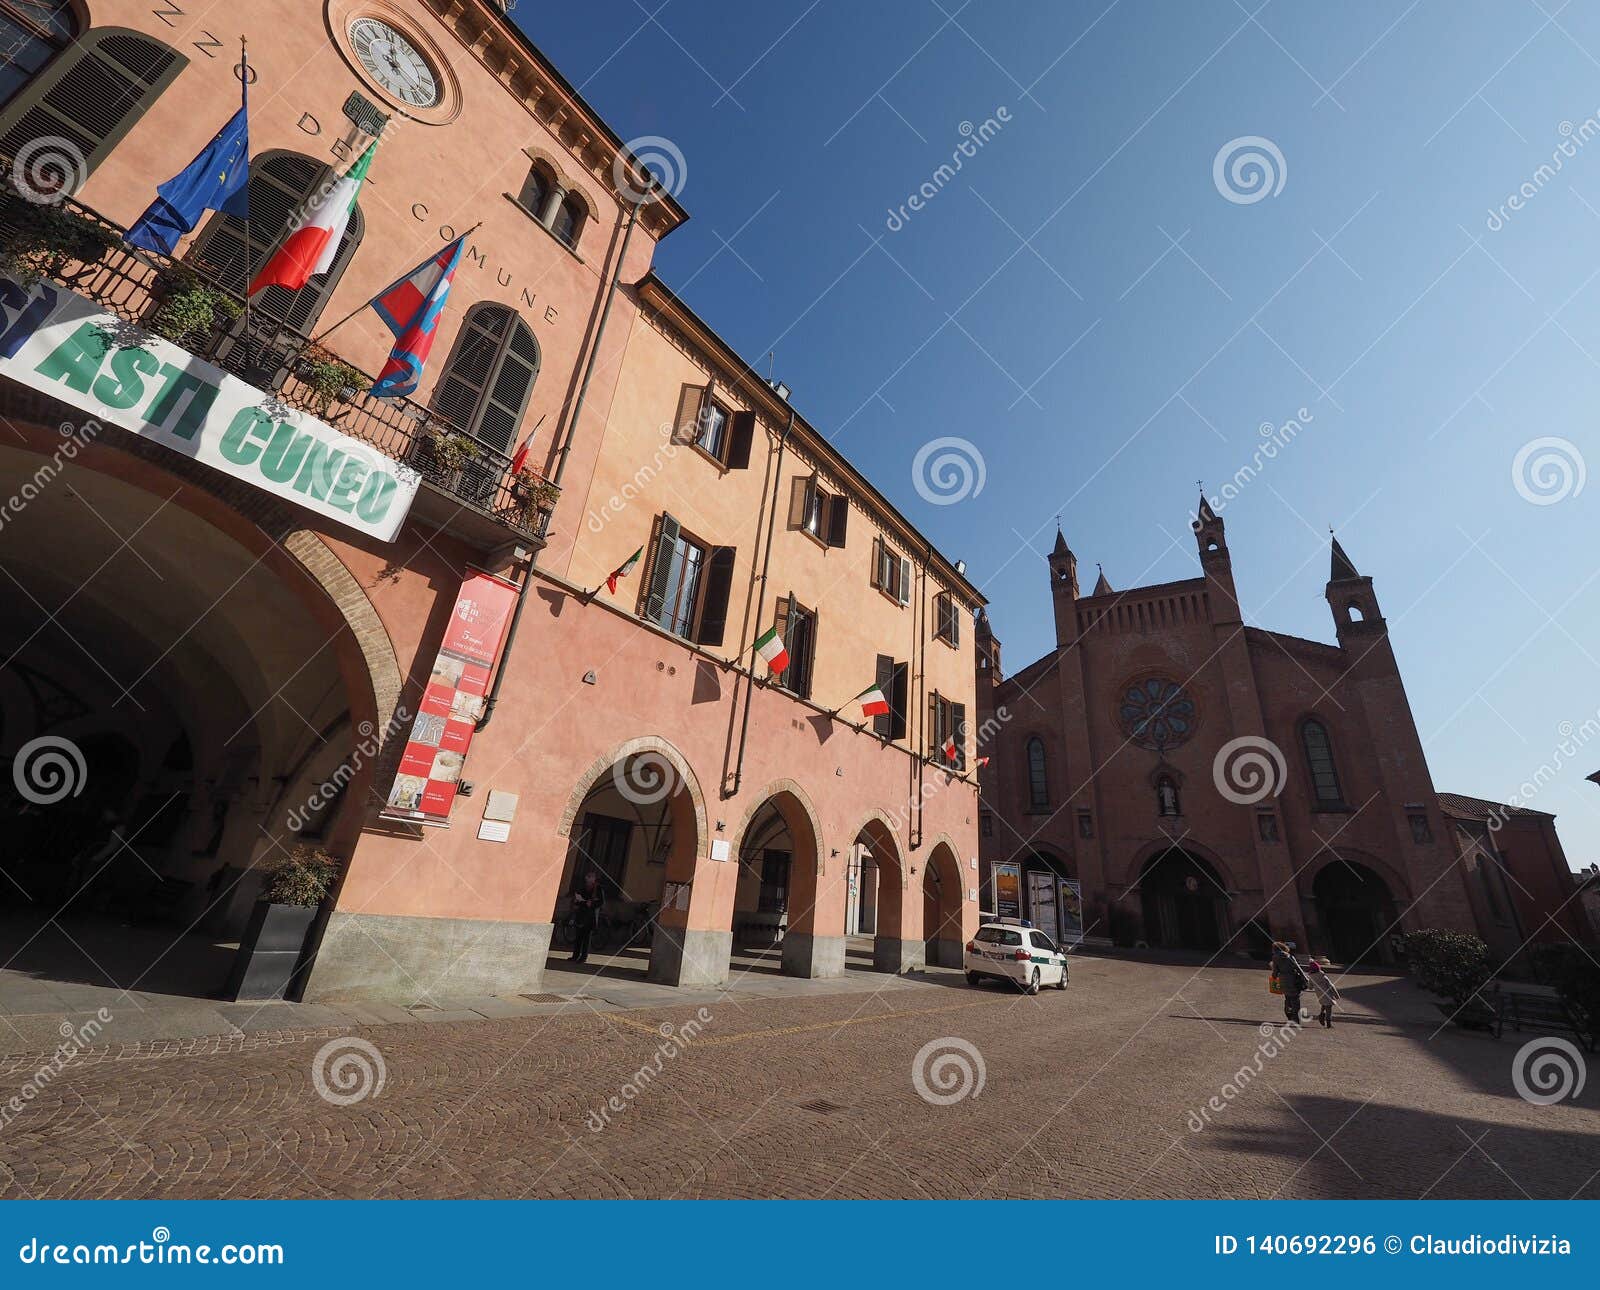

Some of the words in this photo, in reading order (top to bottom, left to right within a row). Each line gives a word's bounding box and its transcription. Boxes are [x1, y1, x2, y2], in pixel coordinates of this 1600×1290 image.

[411, 203, 559, 325] COMUNE
[34, 320, 221, 440] ASTI
[219, 406, 398, 524] CUNEO
